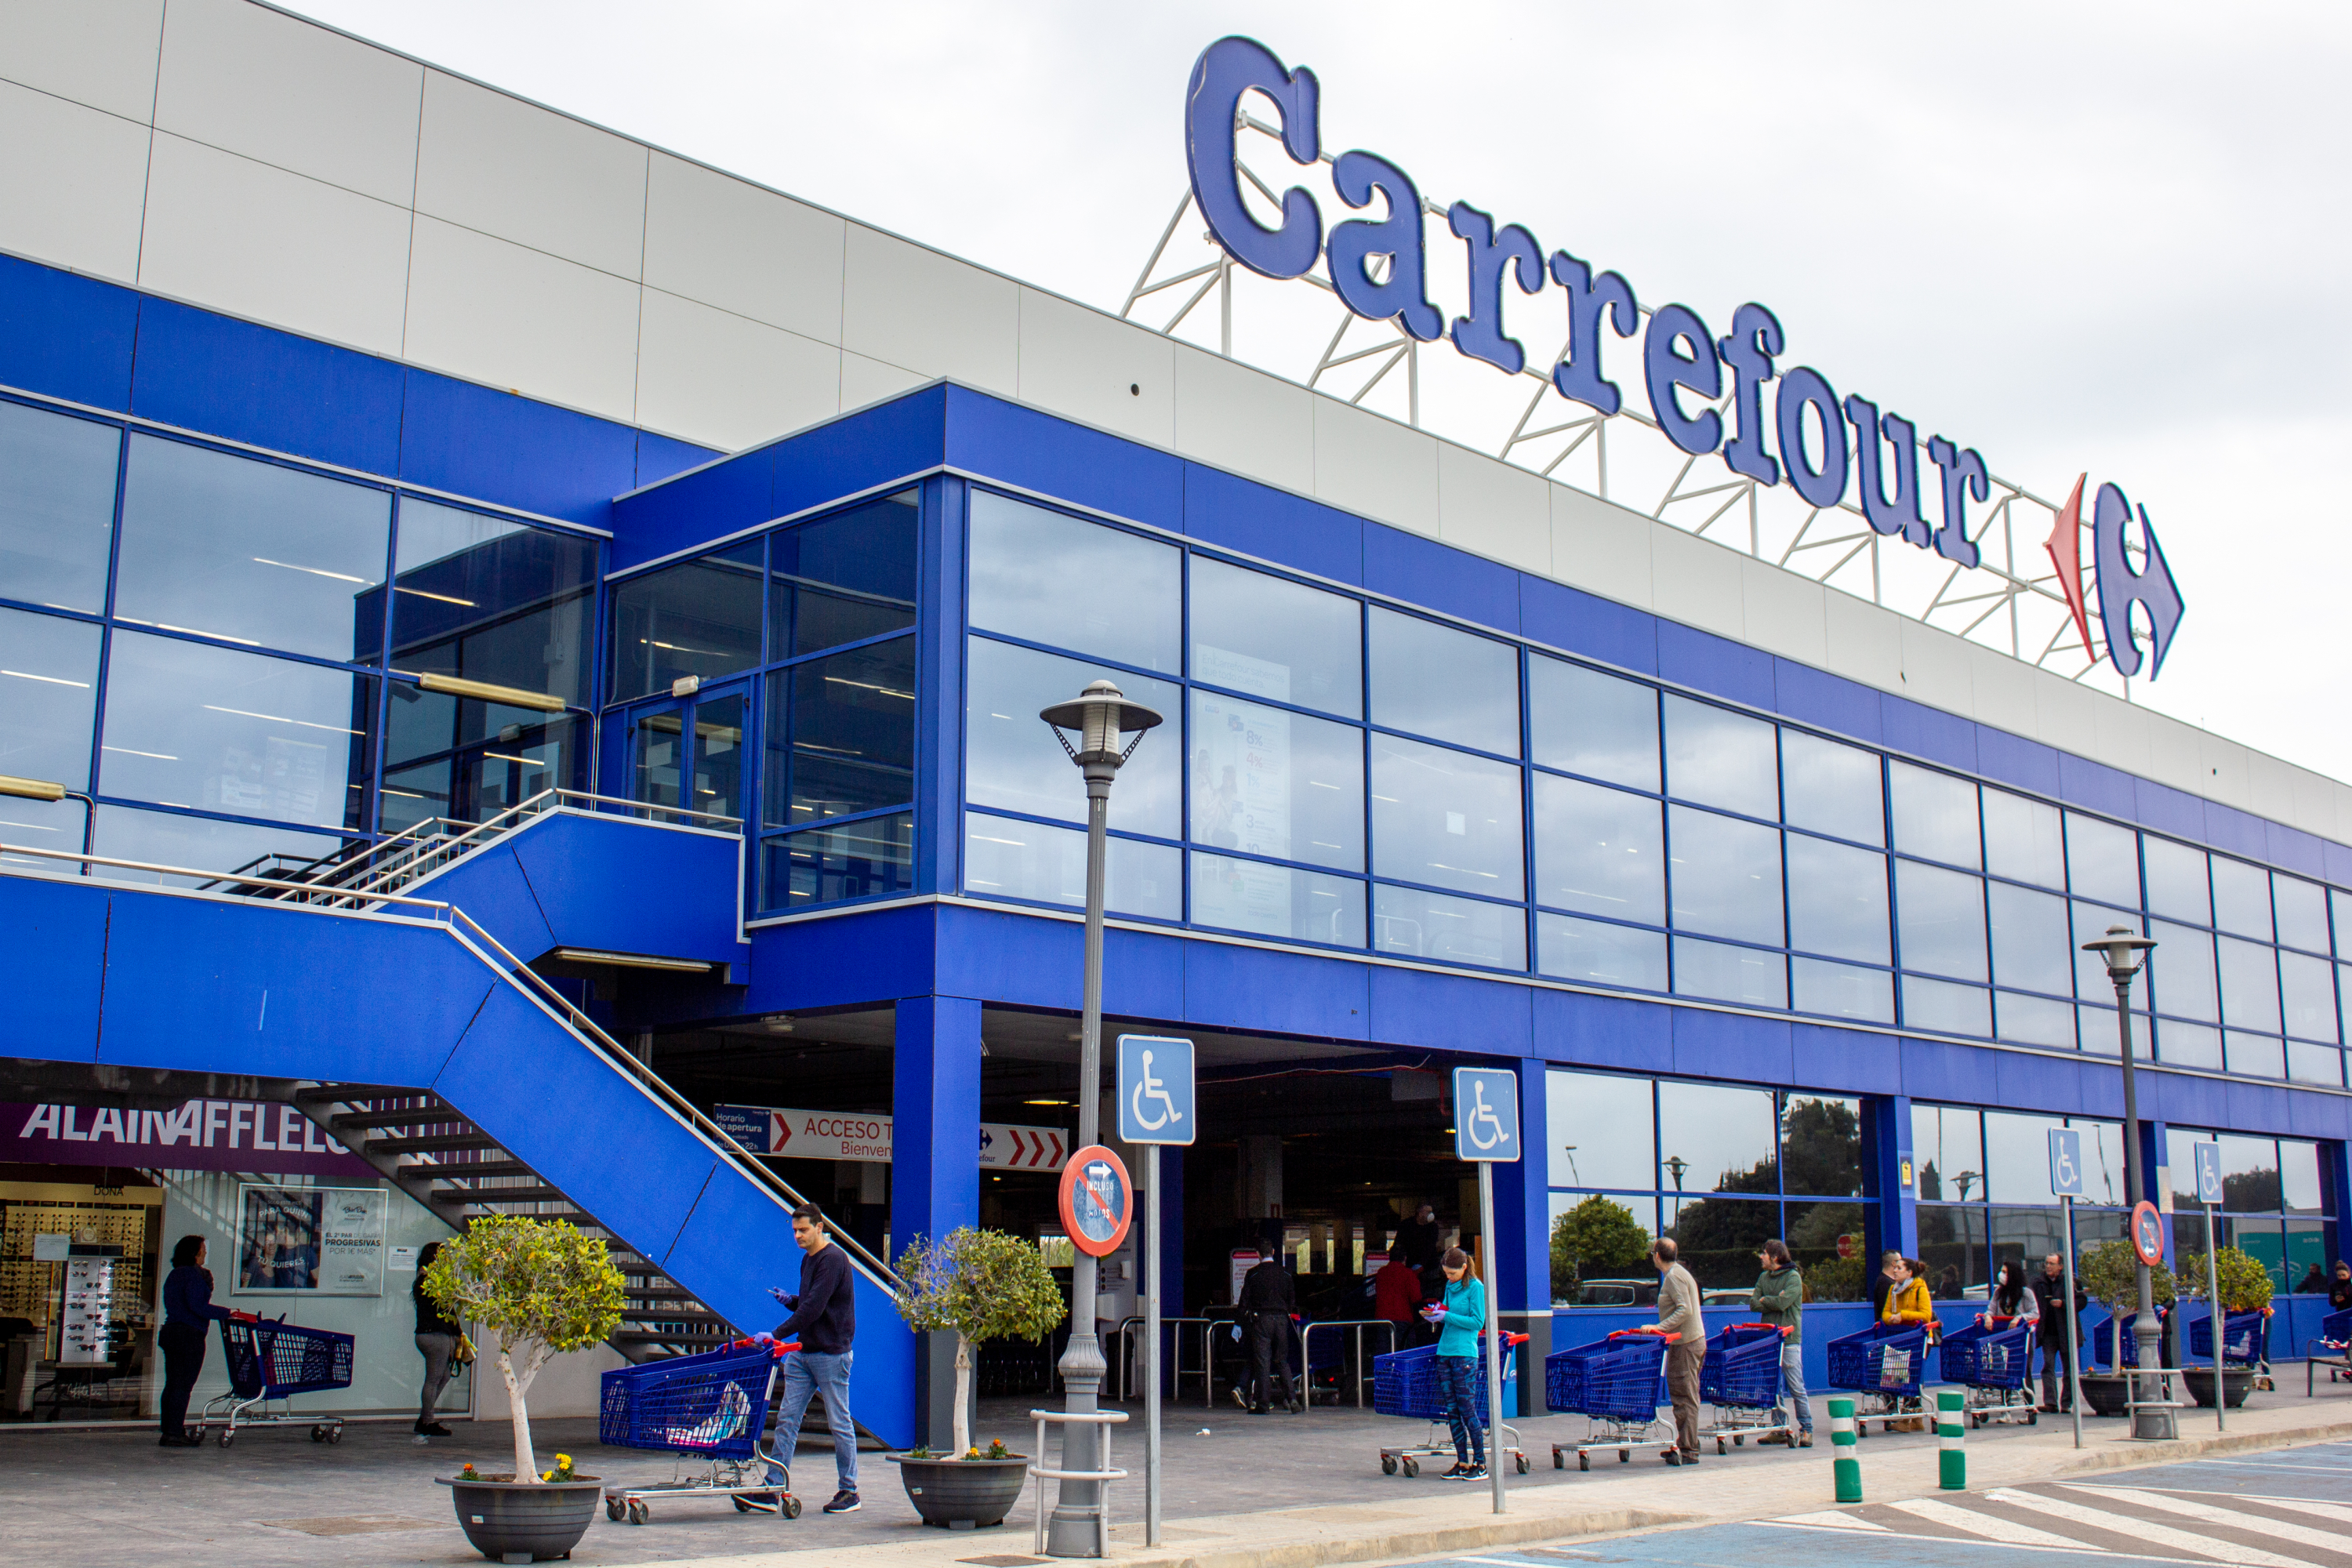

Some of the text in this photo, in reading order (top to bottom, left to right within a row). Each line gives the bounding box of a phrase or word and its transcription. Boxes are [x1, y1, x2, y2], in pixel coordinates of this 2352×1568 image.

[1185, 35, 1991, 568] Carrefour
[1218, 670, 1236, 682] todo
[1246, 729, 1263, 746] 8%
[1246, 752, 1263, 768] 4%
[1246, 772, 1261, 788] 1%
[1246, 814, 1254, 829] 3
[716, 1113, 746, 1123] Horario
[728, 1123, 762, 1133] apertura
[804, 1118, 880, 1140] ACCESO
[1087, 1180, 1113, 1192] INCLUSO
[259, 1206, 281, 1218] PARA
[325, 1239, 381, 1247] PROGRESIVAS
